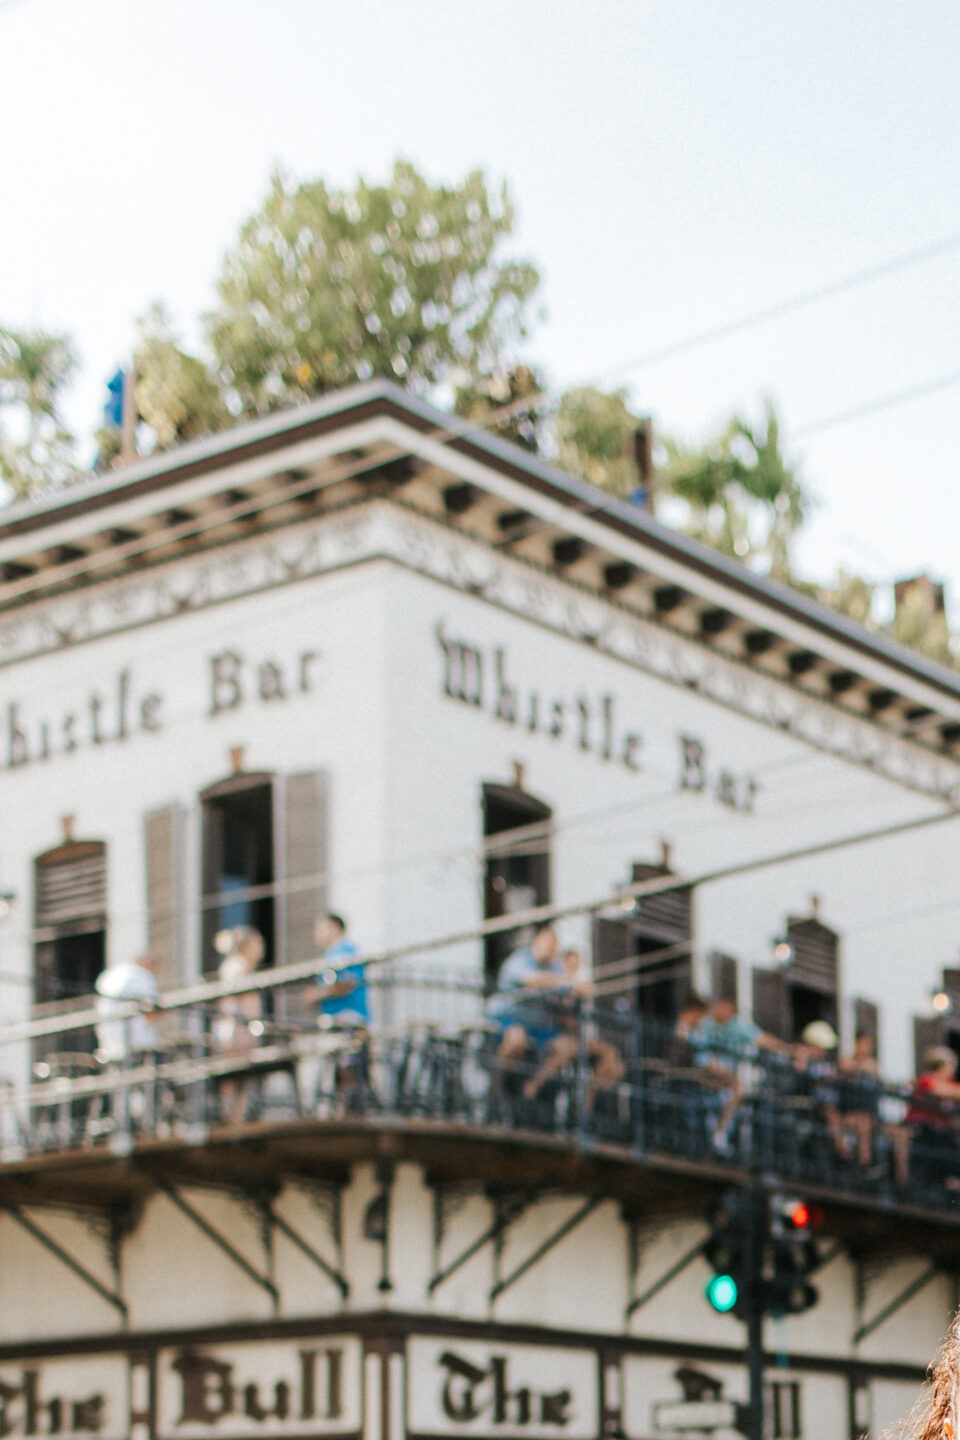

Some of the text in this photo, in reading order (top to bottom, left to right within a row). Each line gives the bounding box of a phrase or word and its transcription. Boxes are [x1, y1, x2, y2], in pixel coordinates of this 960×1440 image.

[206, 646, 321, 719] Bar
[433, 614, 762, 815] Whistle Bar
[171, 1350, 344, 1424] Bull
[438, 1351, 800, 1440] The Bll
